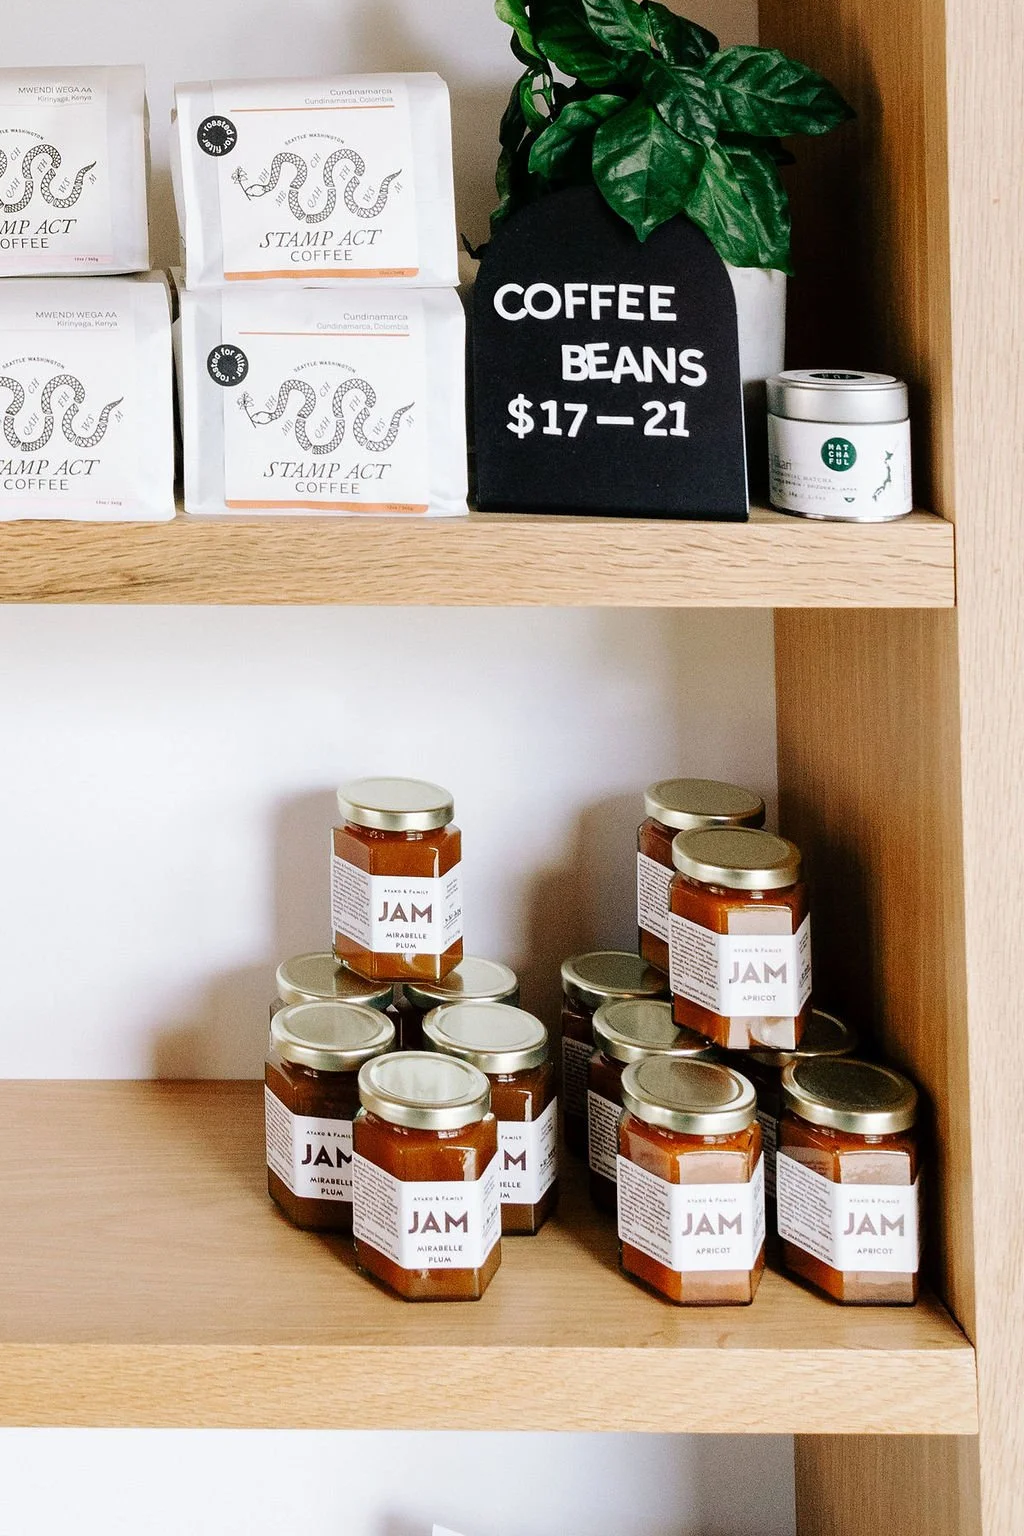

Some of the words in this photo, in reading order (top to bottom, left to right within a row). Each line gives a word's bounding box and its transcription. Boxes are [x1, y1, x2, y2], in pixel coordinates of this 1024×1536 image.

[37, 218, 77, 235] ACT
[259, 231, 333, 248] STAMP
[337, 229, 382, 246] ACT
[290, 249, 353, 262] COFFEE
[493, 282, 677, 322] COFFEE
[343, 313, 408, 321] Cundinamarca
[561, 342, 707, 388] BEANS
[55, 459, 100, 475] ACT
[828, 458, 849, 466] FUL
[263, 462, 341, 479] STAMP
[345, 462, 391, 480] ACT
[3, 479, 69, 491] COFFEE
[295, 482, 360, 495] COFFEE
[378, 901, 432, 924] JAM
[385, 932, 427, 940] MIRABELLE
[728, 961, 787, 984] JAM
[301, 1143, 353, 1168] JAM
[321, 1188, 344, 1197] PLUM
[408, 1210, 468, 1234] JAM
[682, 1212, 743, 1236] JAM
[843, 1212, 905, 1237] JAM
[695, 1247, 731, 1255] APRICOT
[856, 1247, 893, 1255] APRICOT
